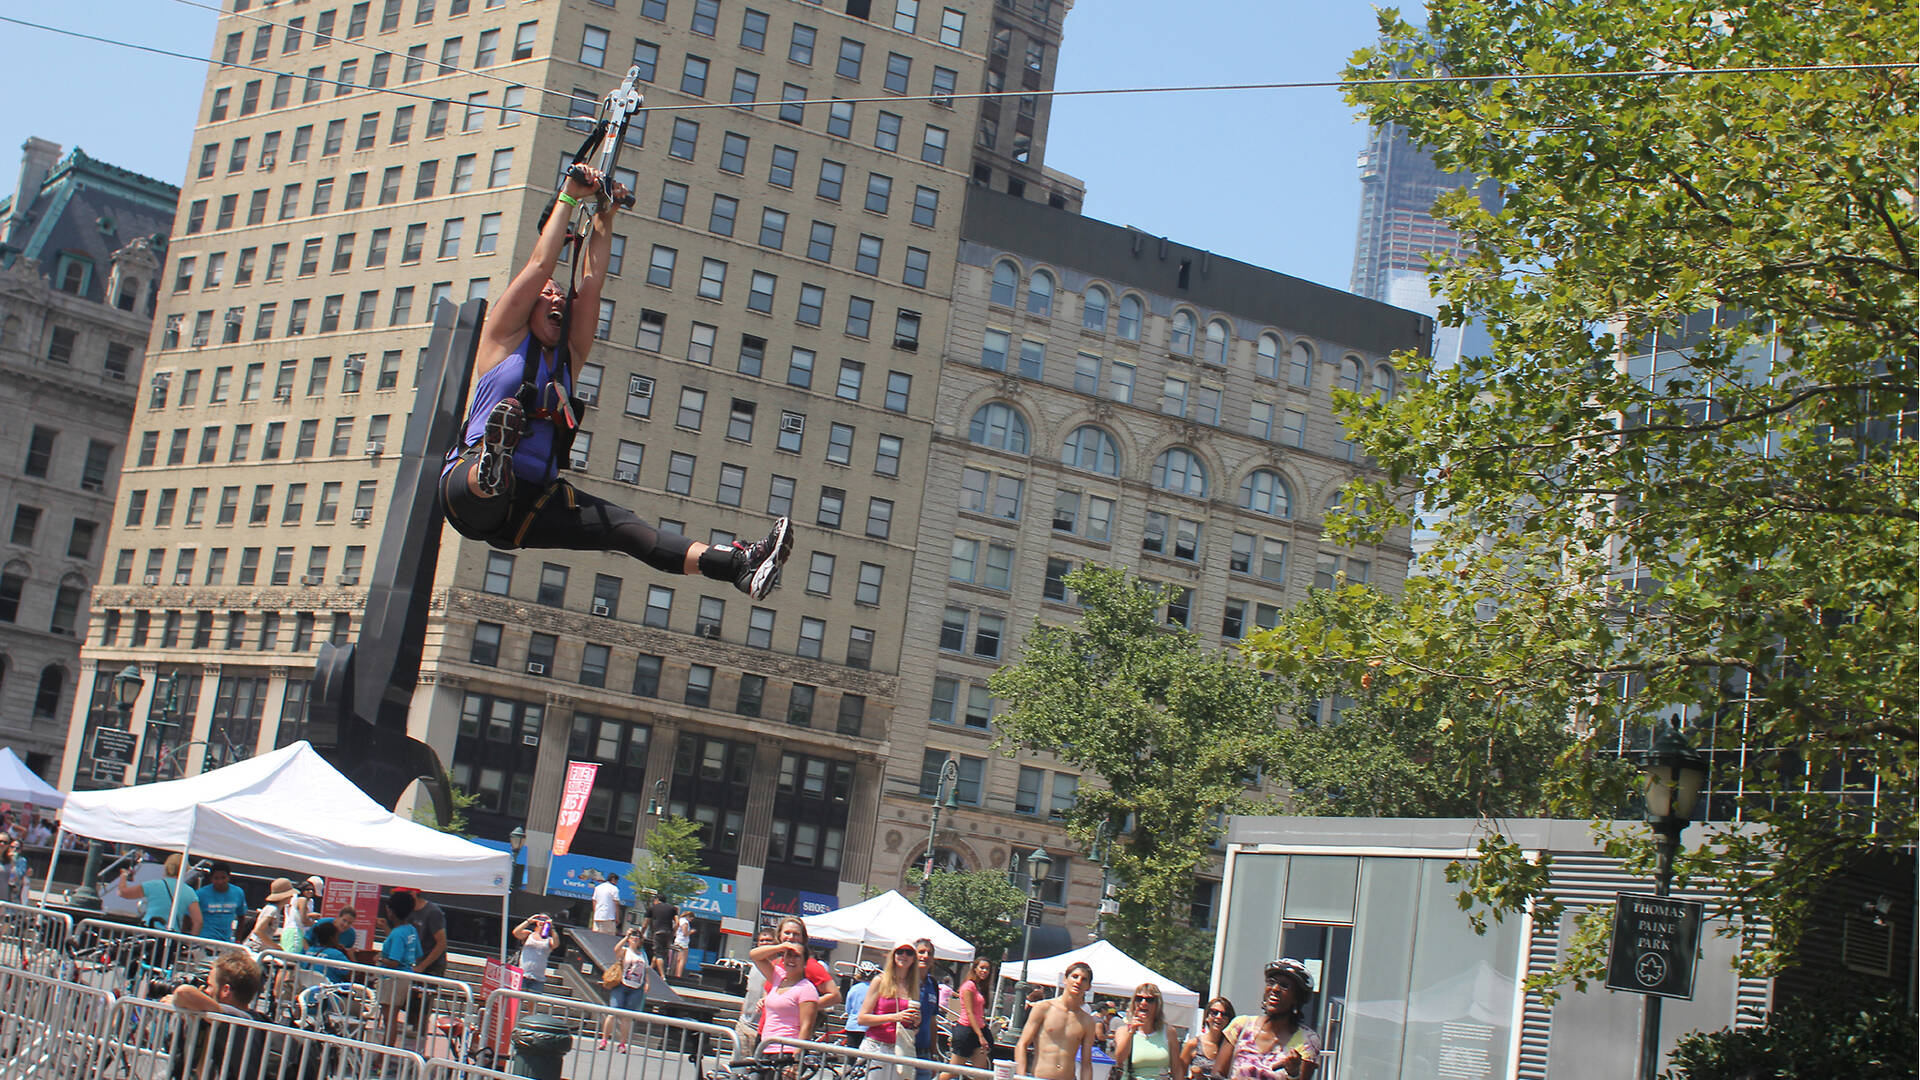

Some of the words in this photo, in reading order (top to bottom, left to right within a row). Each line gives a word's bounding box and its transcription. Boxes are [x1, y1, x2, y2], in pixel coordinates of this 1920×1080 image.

[1633, 902, 1687, 918] THOMAS
[1638, 920, 1676, 934] PAINE
[1637, 937, 1670, 951] PARK
